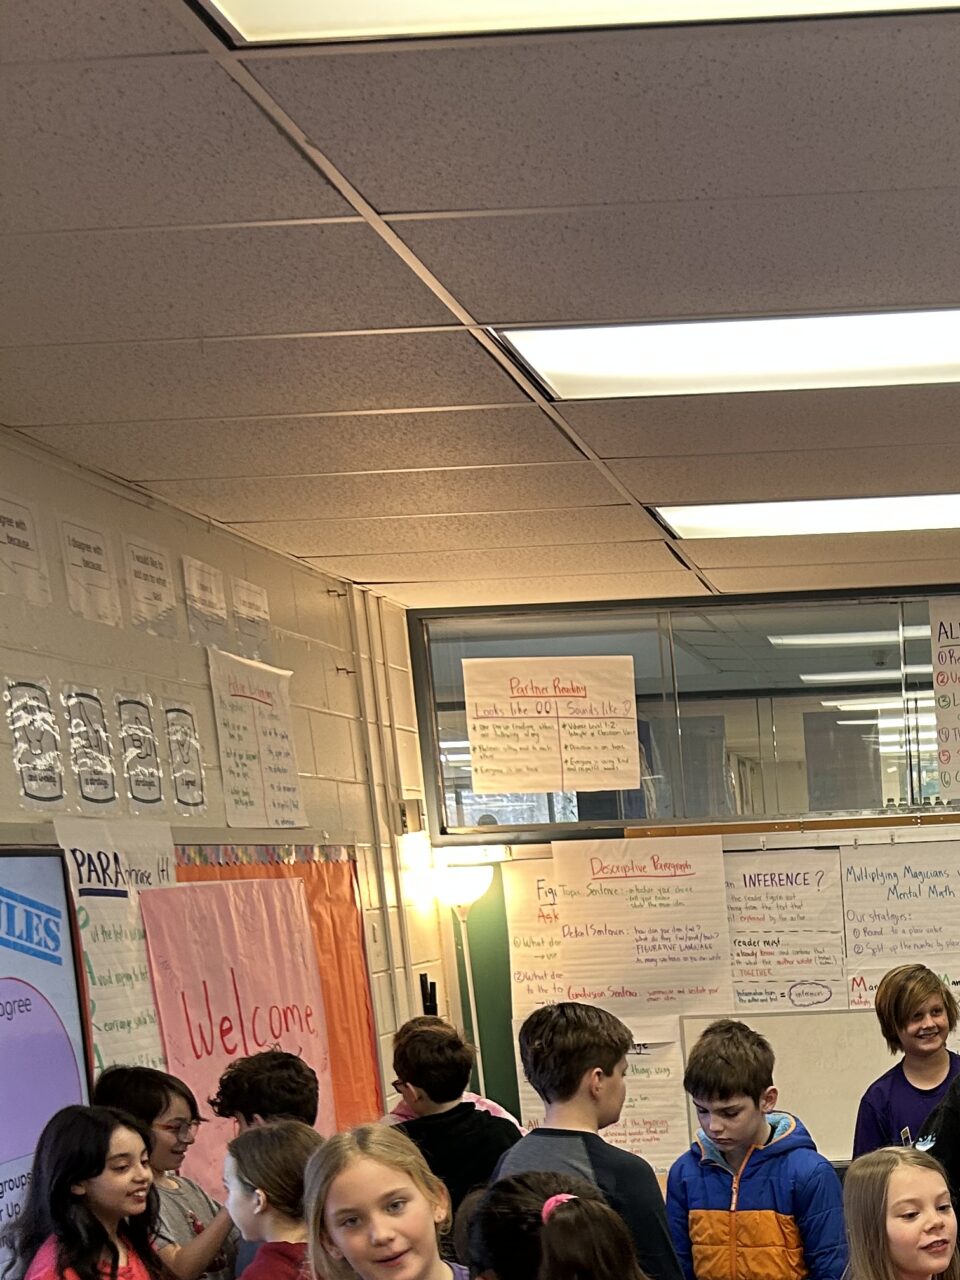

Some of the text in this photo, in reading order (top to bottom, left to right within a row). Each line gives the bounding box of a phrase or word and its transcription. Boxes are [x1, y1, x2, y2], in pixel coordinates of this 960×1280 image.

[509, 676, 586, 697] Partner Reading
[475, 701, 528, 718] Looks like
[567, 700, 617, 716] Sounds like
[71, 848, 152, 888] PARAphrase
[590, 854, 692, 877] Descriptive Paragraph
[846, 866, 899, 885] Multiplying
[903, 865, 950, 884] Magicians
[887, 883, 956, 901] Mental Math
[538, 907, 560, 924] Ask
[846, 909, 866, 921] Our
[181, 967, 316, 1060] Welcome
[7, 1202, 21, 1220] Up
